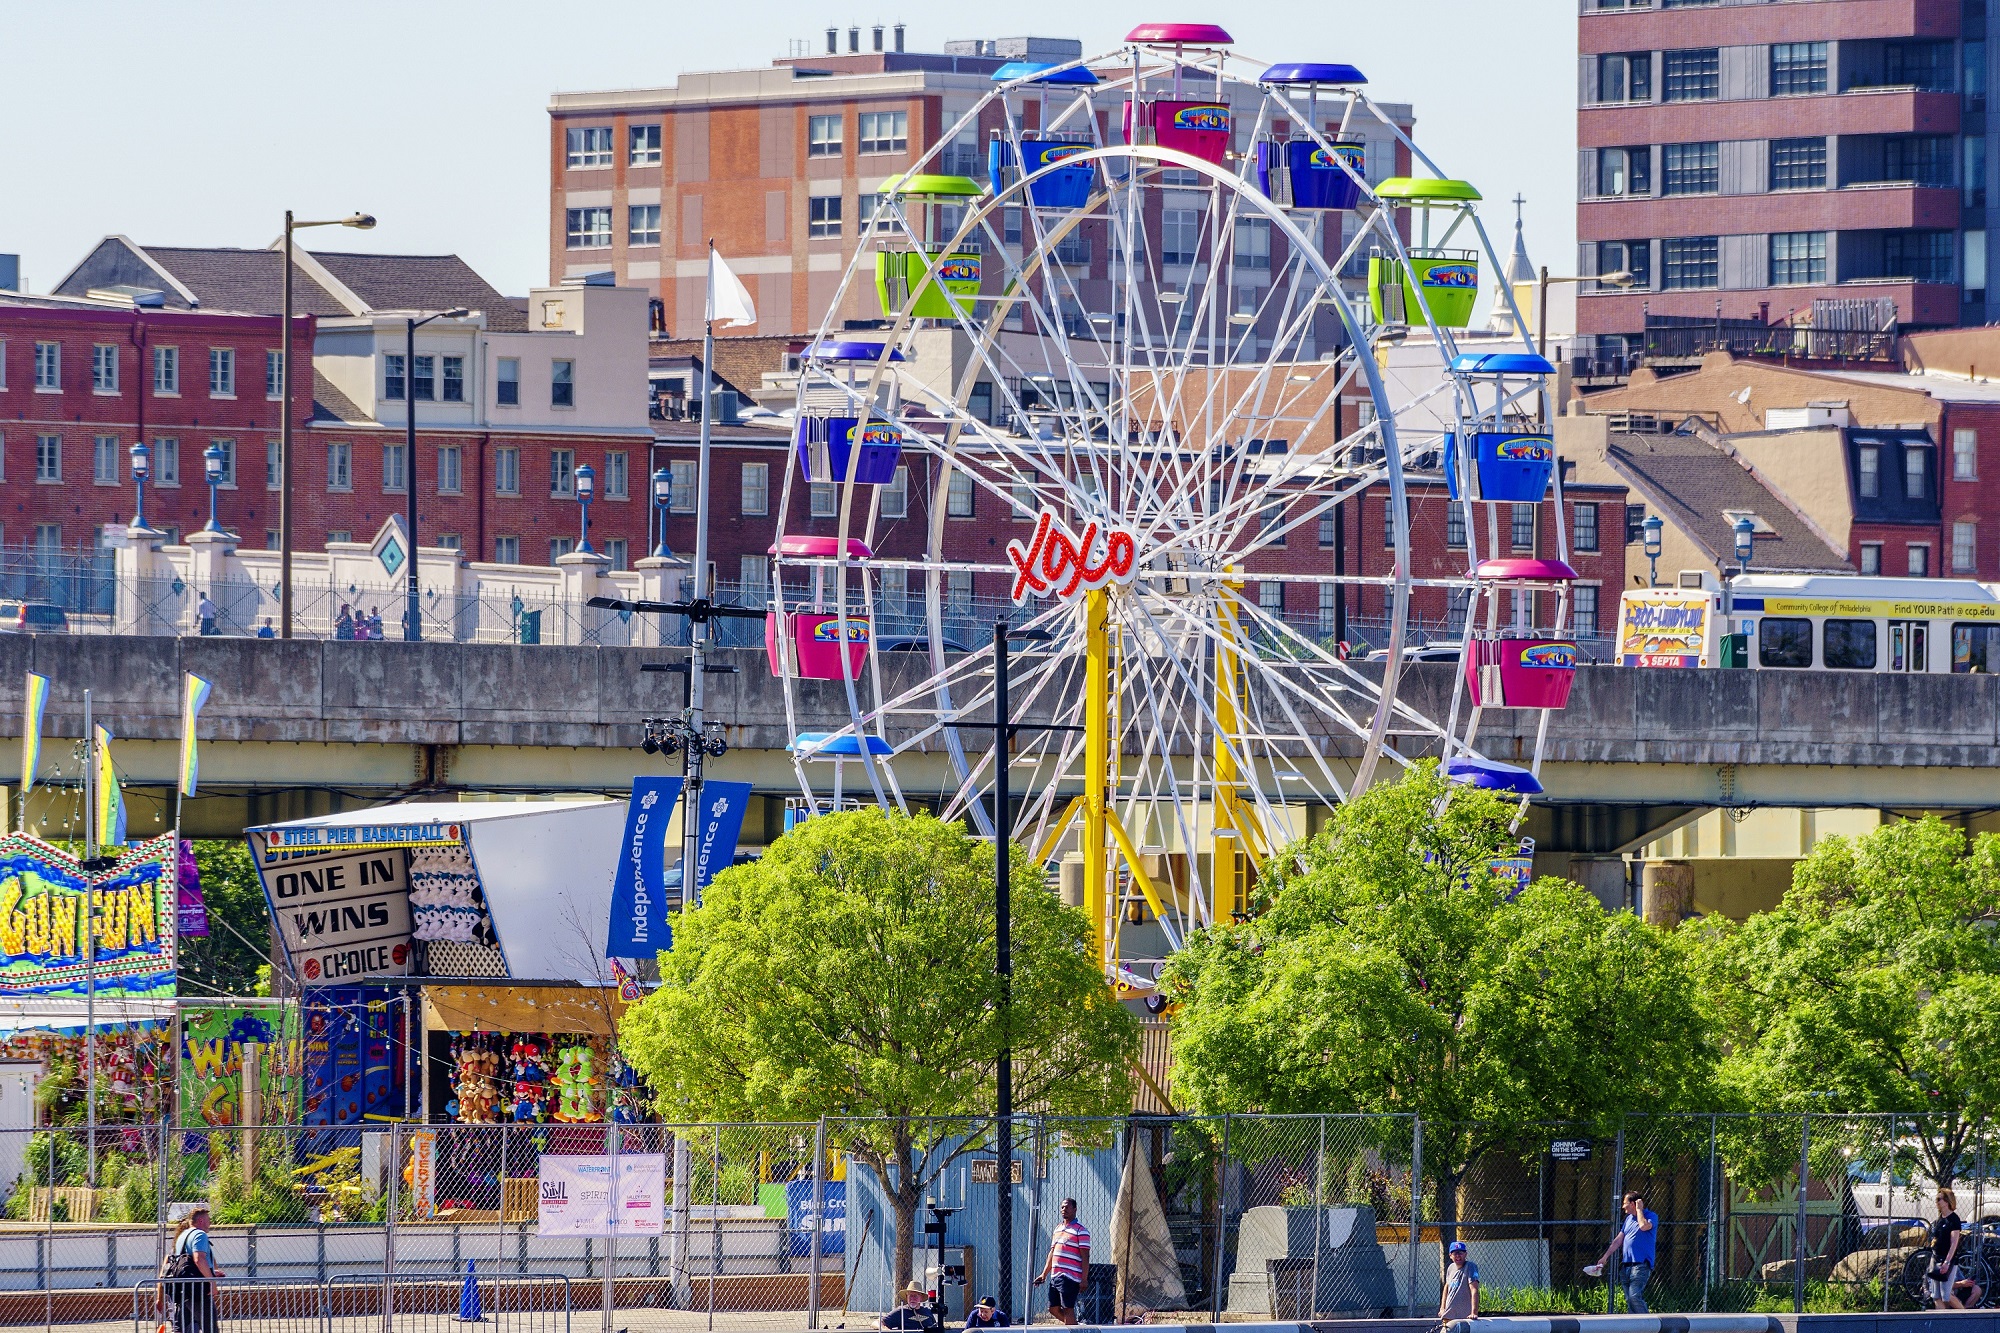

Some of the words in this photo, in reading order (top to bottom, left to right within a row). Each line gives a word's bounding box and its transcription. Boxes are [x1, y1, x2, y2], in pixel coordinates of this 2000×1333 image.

[1776, 603, 1808, 613] Community
[1809, 603, 1829, 613] College
[1829, 601, 1839, 615] of
[1839, 604, 1872, 614] Philadelphia
[1894, 604, 1911, 614] Find
[1912, 605, 1936, 615] YOUR
[1937, 605, 1955, 615] Path
[1956, 607, 1964, 617] @
[1964, 607, 1995, 618] ccp.edu
[1651, 656, 1680, 667] SEPTA
[284, 829, 321, 846] STEEL
[327, 827, 357, 844] PIER
[361, 825, 444, 843] BASKETBALL
[276, 865, 346, 899] ONE
[358, 857, 395, 886] IN
[631, 813, 652, 943] Independence
[0, 876, 76, 957] GUN
[81, 881, 156, 960] FUN
[294, 902, 389, 937] WINS
[322, 946, 389, 979] CHOICE
[367, 1000, 387, 1013] WIN
[201, 1083, 296, 1126] GN
[580, 1190, 609, 1200] SPIRIT
